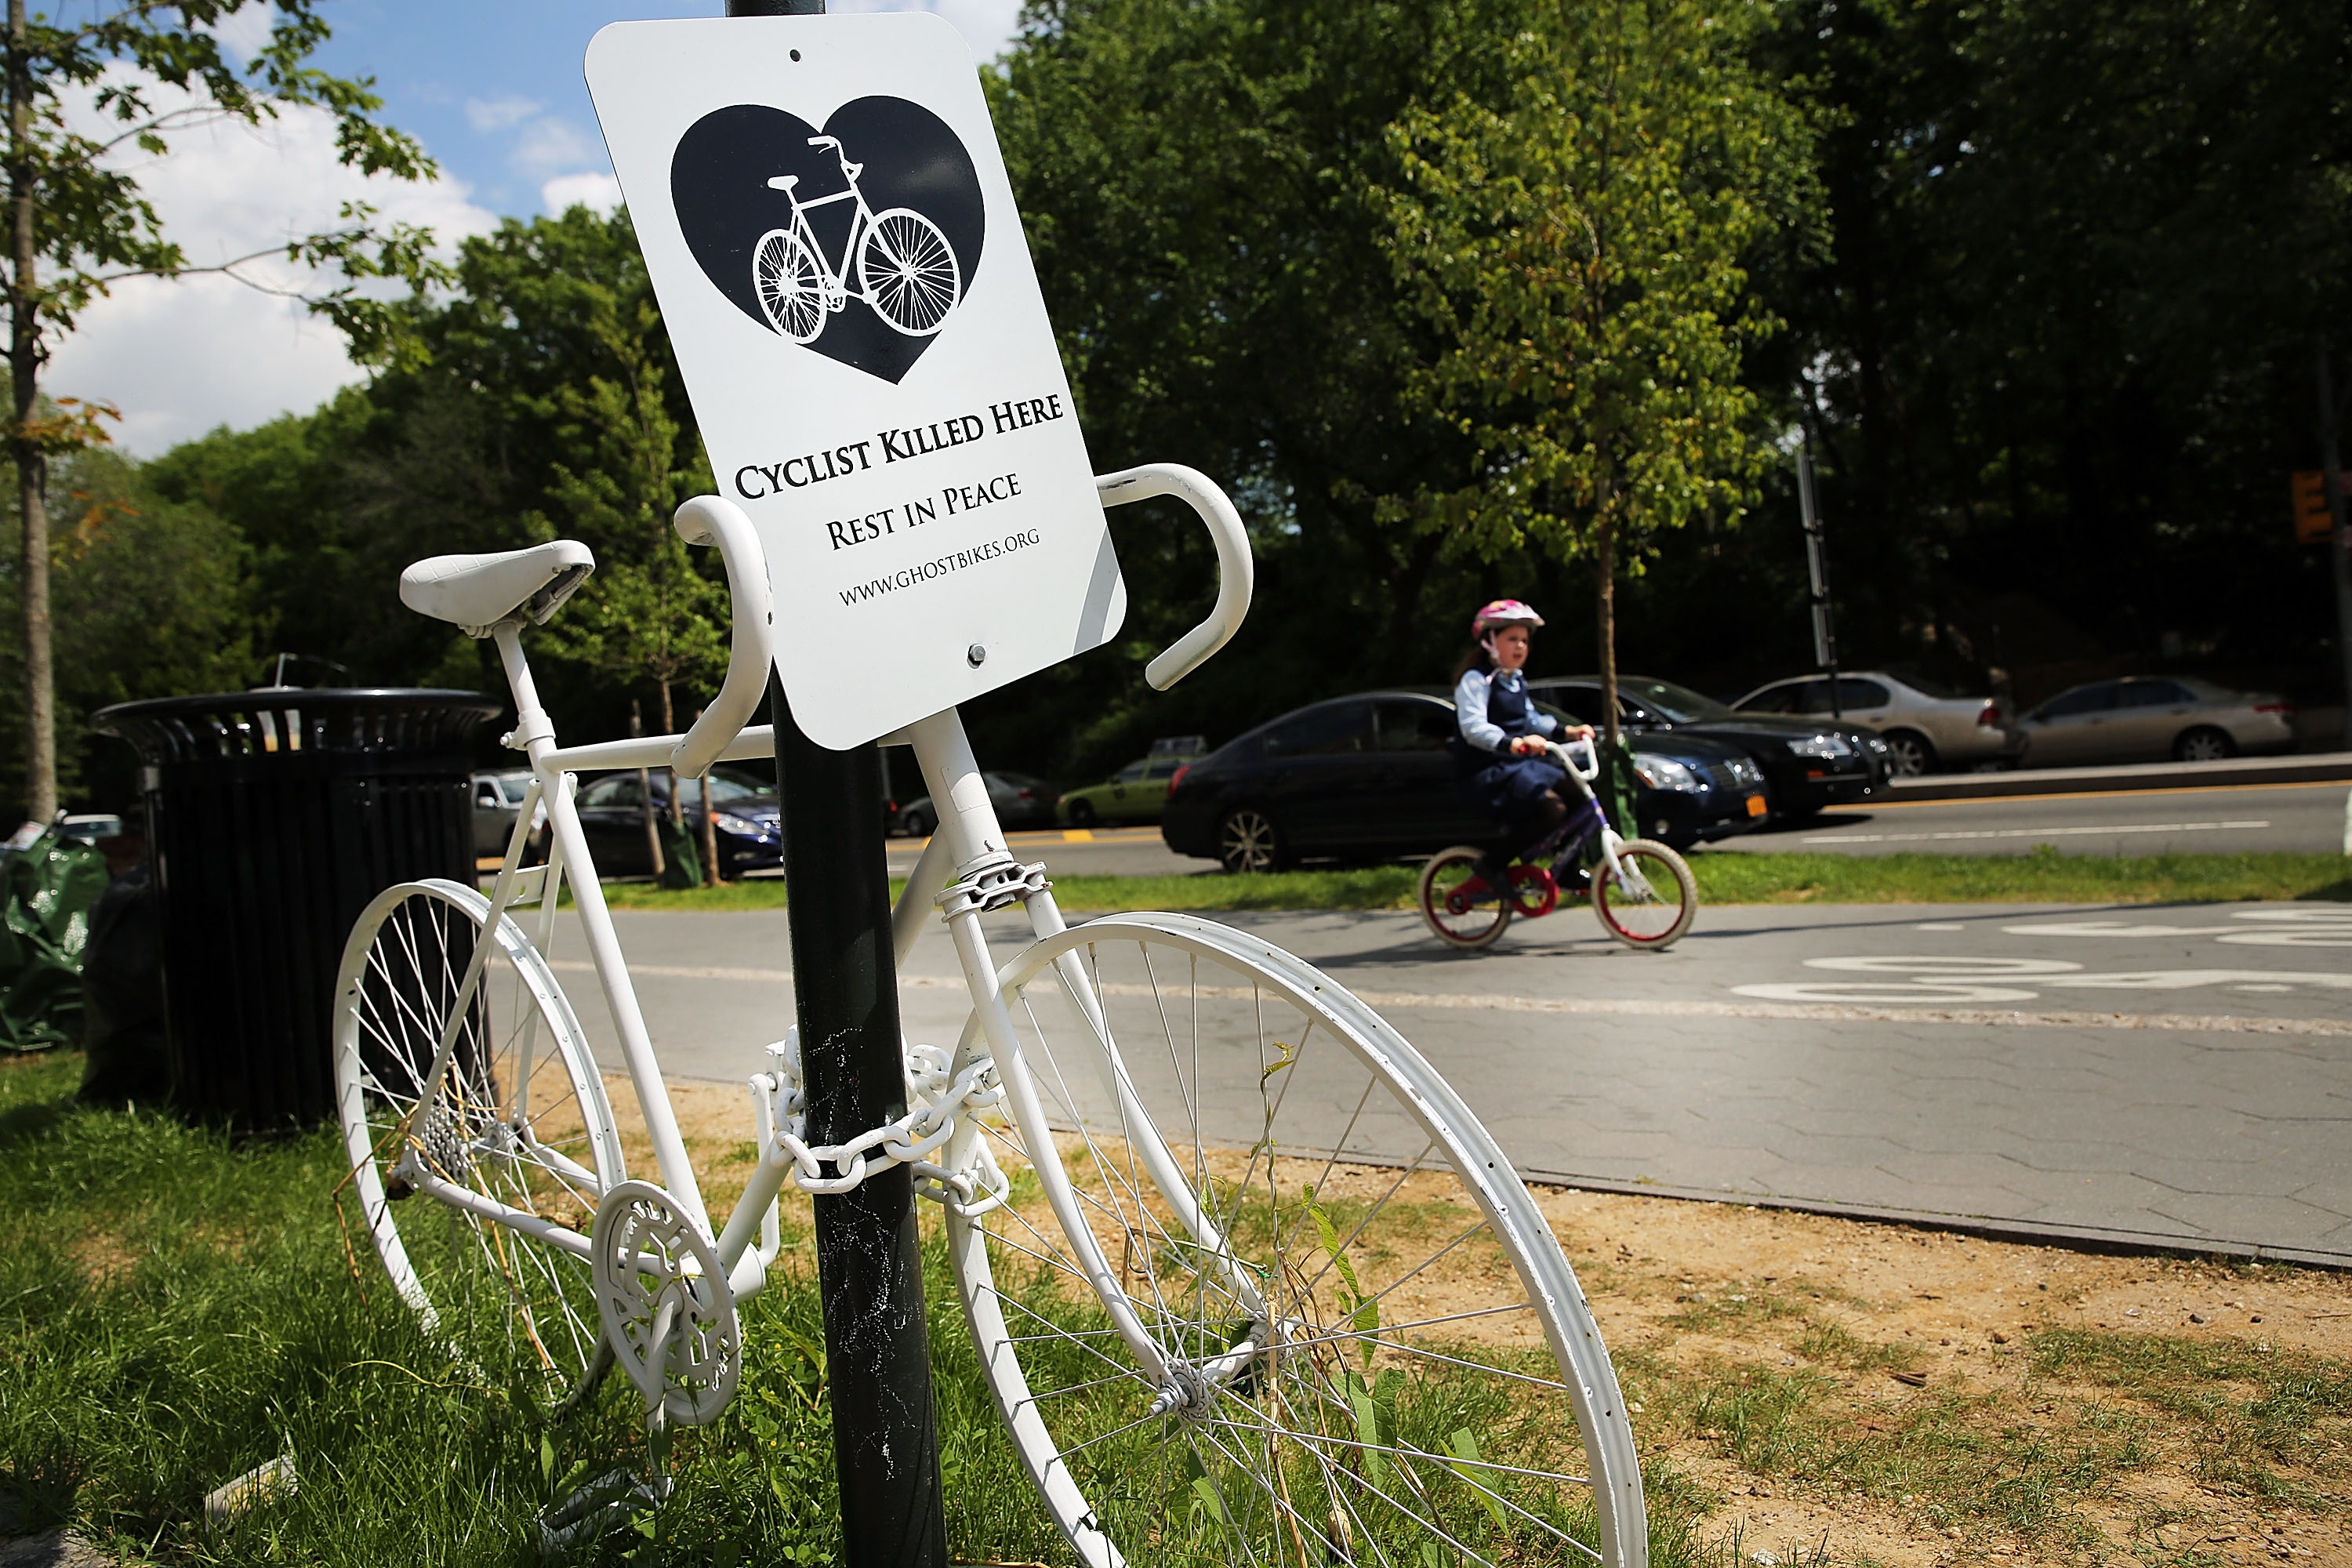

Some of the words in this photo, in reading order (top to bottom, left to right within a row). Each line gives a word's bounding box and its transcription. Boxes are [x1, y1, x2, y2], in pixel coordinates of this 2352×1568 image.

[735, 441, 871, 499] CYCLIST
[877, 415, 984, 464] KILLED
[988, 394, 1064, 434] HERE
[826, 508, 895, 551] REST
[902, 497, 936, 528] IN
[941, 473, 1022, 516] PEACE
[838, 528, 1040, 607] WWW.GHOSTBIKES.ORG
